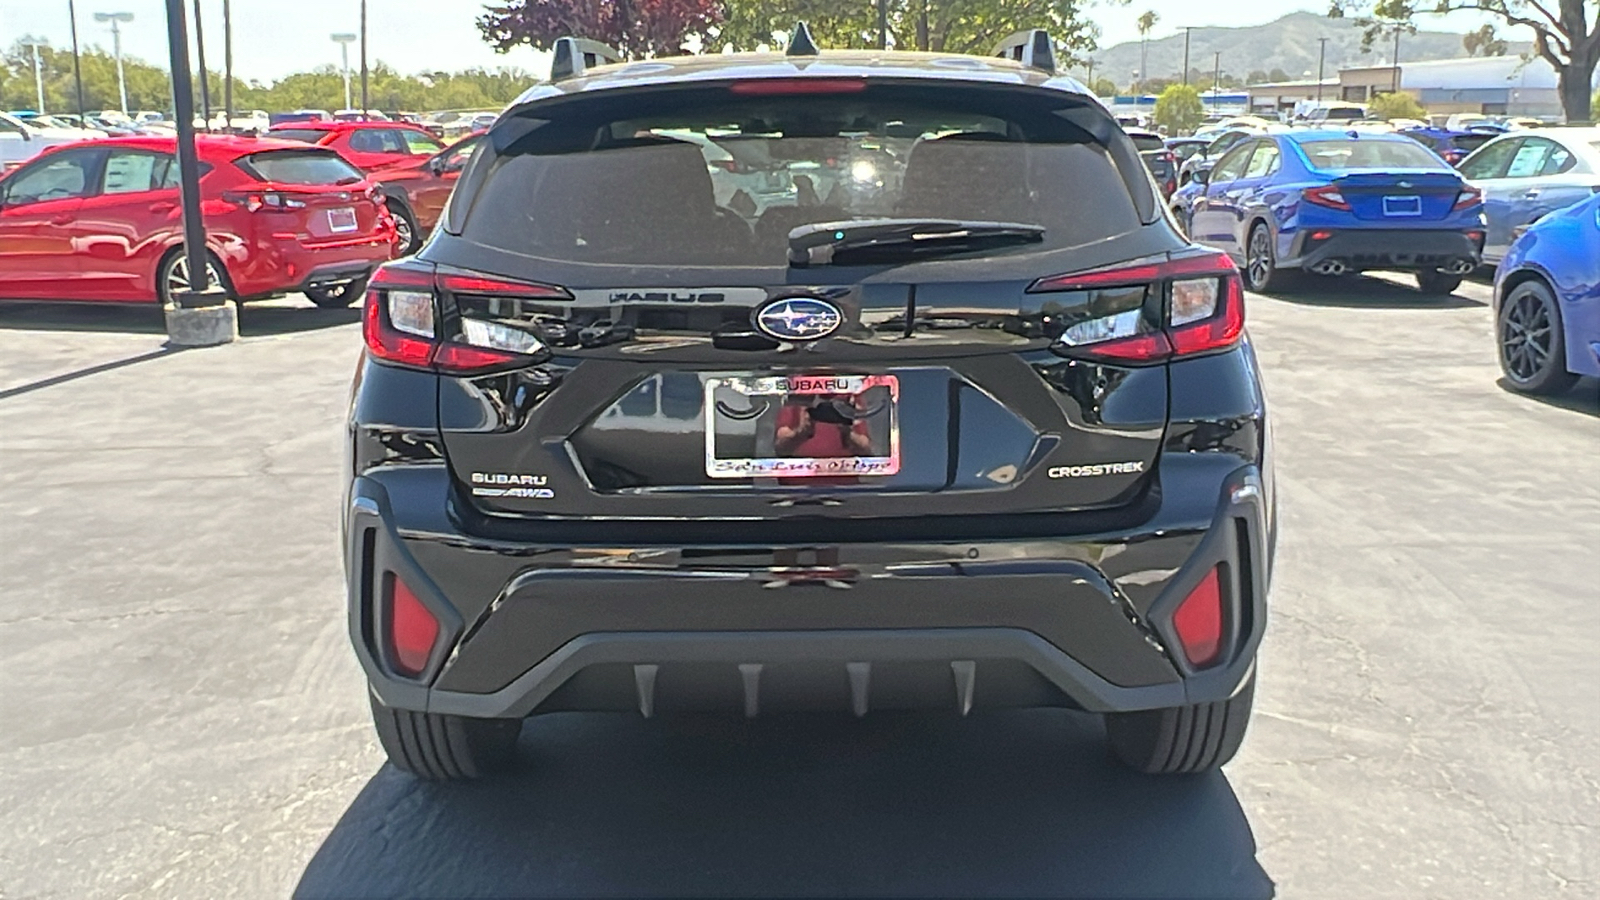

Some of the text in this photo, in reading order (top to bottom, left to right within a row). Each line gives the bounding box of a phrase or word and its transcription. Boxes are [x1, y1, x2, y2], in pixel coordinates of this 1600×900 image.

[775, 380, 849, 391] SUBARU
[1048, 461, 1144, 478] CROSSTREK
[471, 472, 547, 486] SUBARU
[502, 487, 555, 499] AWD
